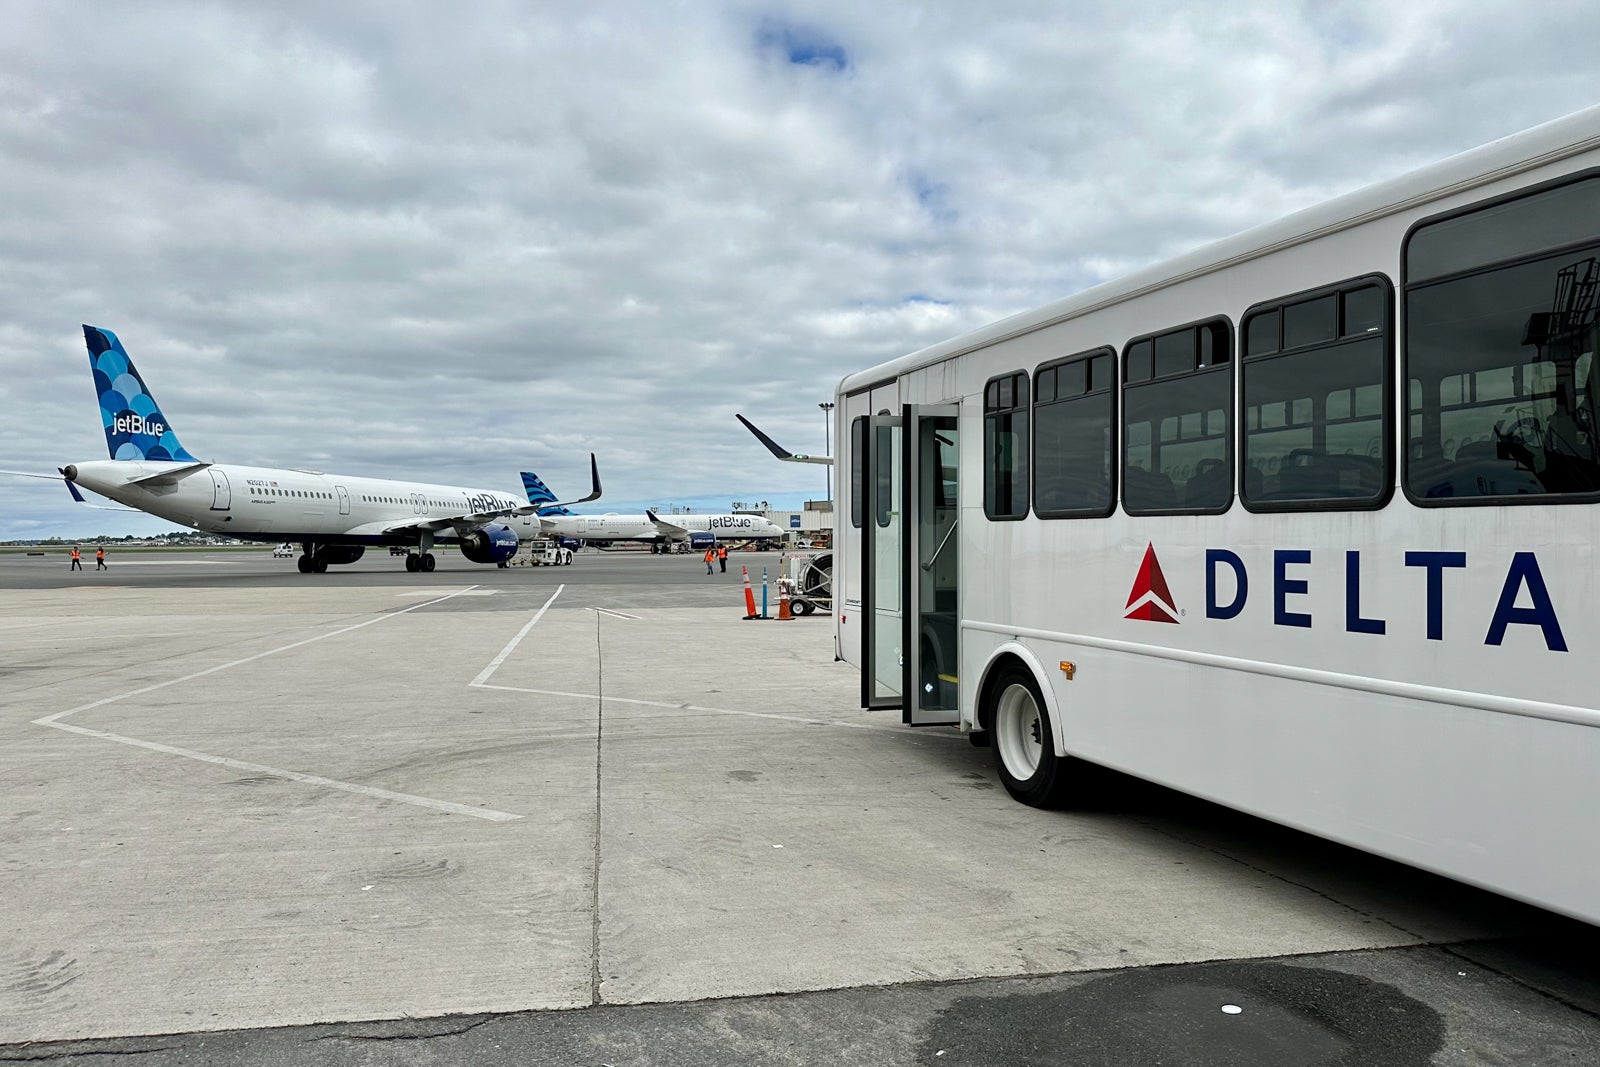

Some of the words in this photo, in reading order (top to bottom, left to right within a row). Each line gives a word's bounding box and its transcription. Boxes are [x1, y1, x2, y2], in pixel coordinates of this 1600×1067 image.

[112, 412, 164, 436] jetBlue
[708, 516, 751, 530] jetBlue
[1205, 548, 1569, 653] DELTA
